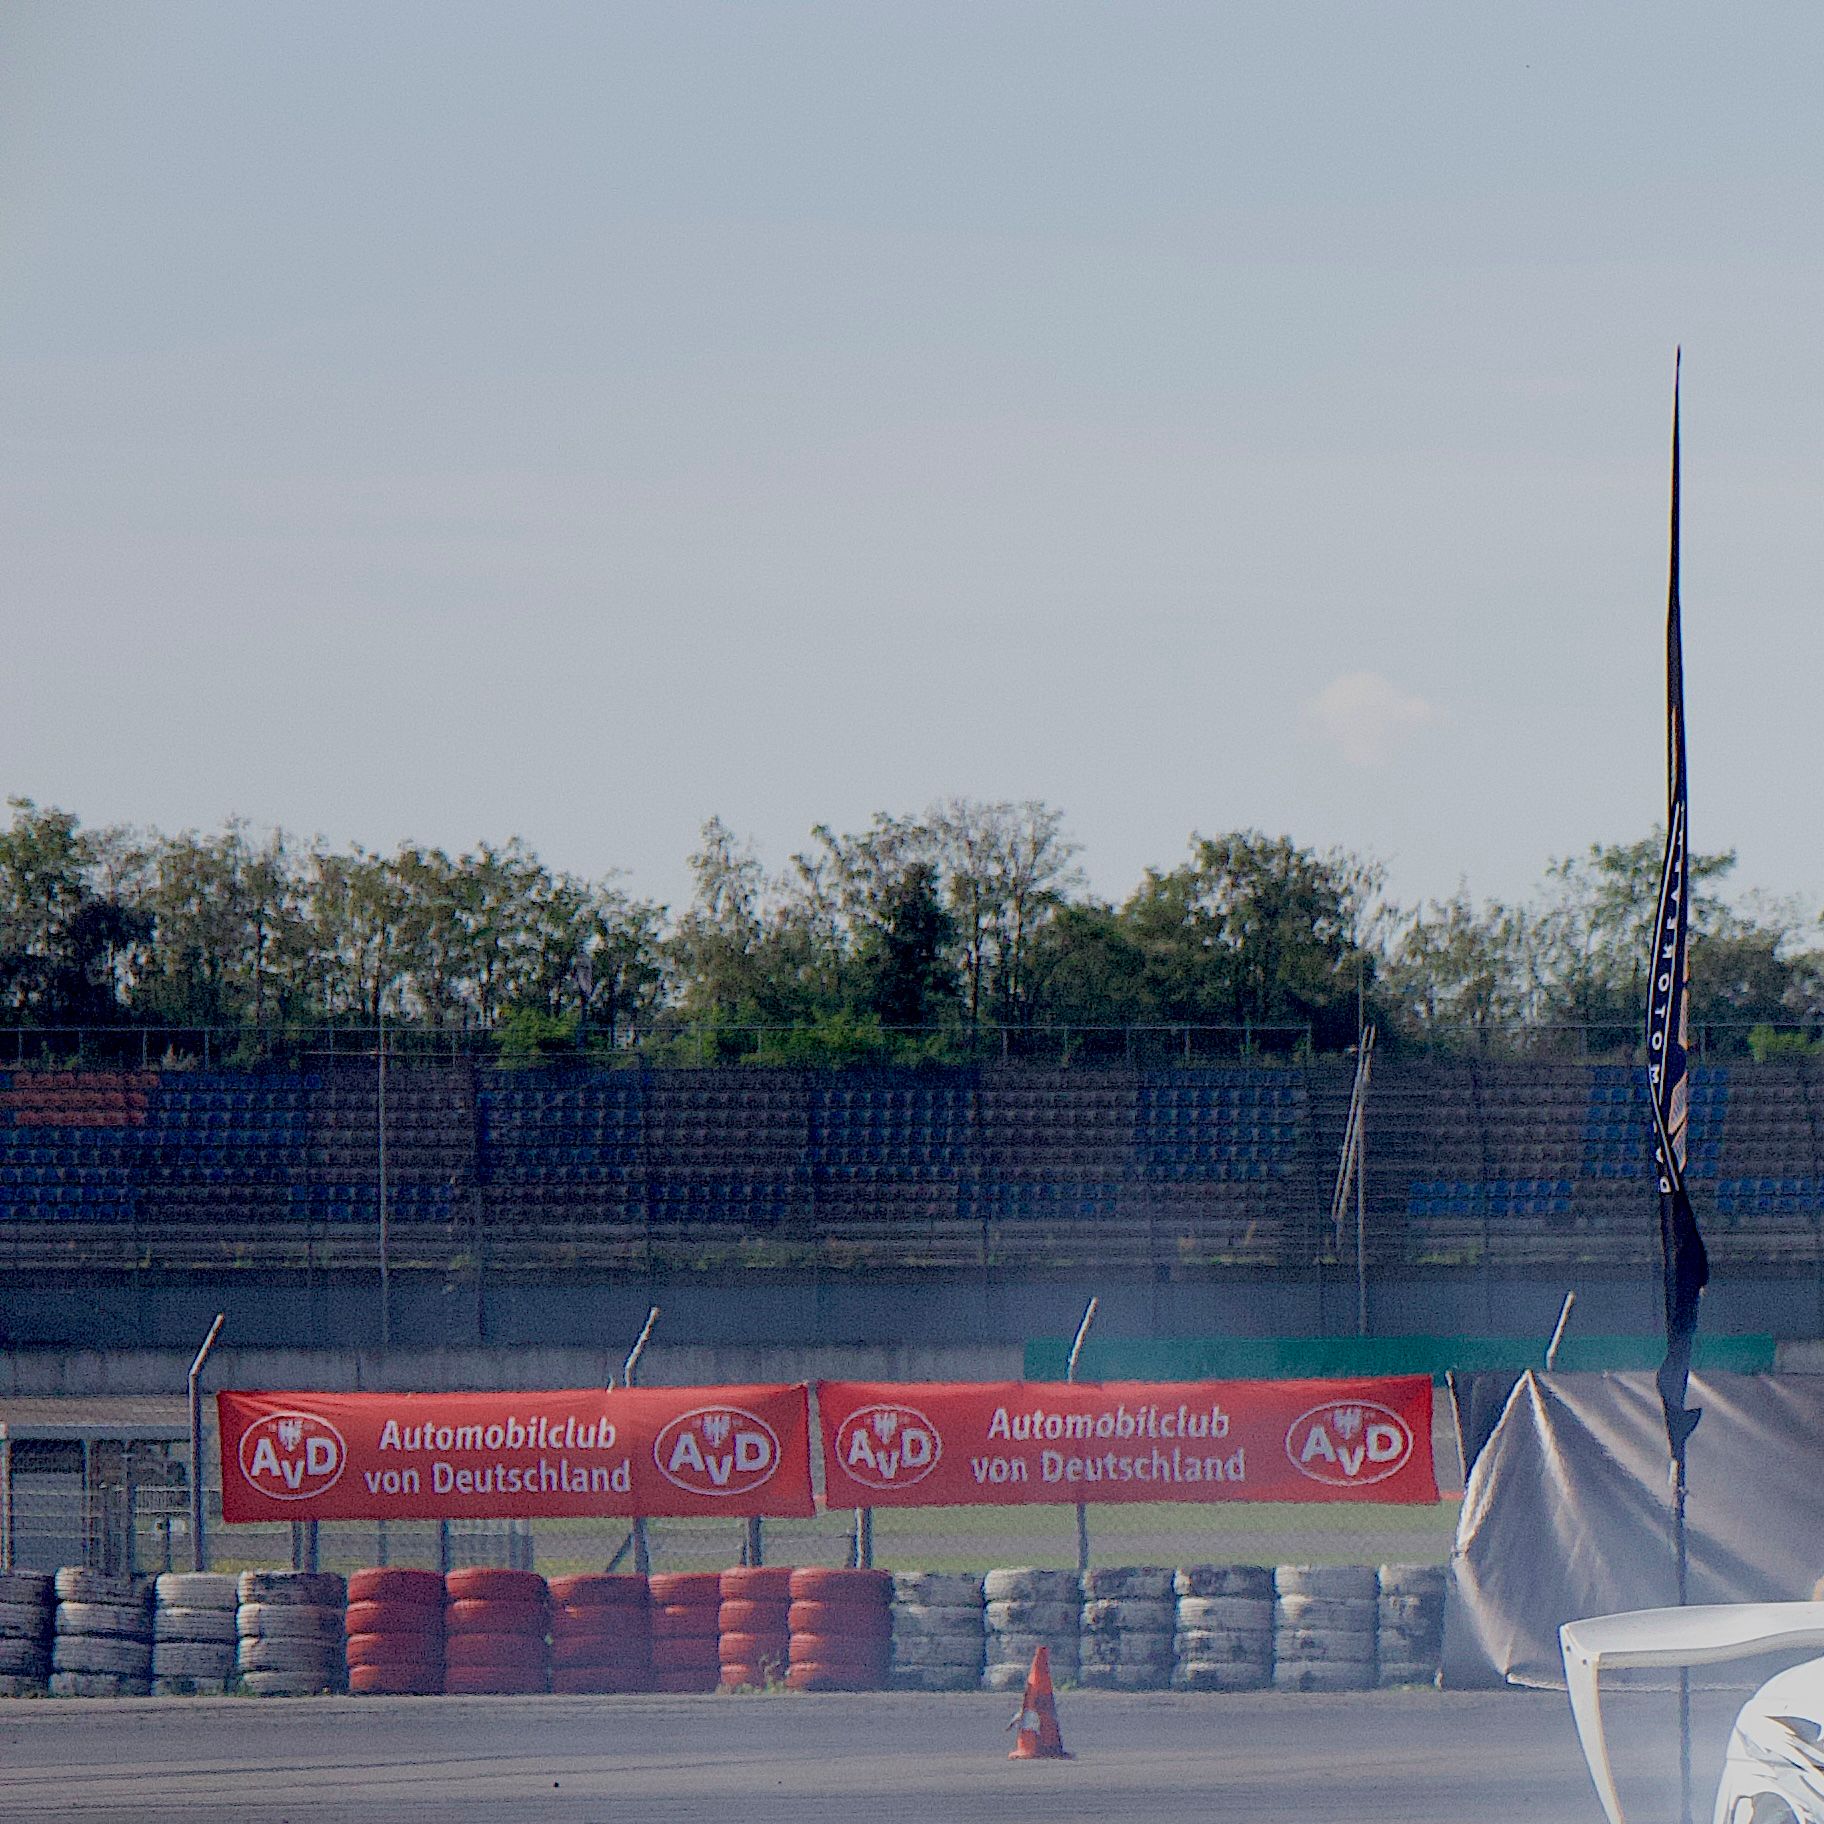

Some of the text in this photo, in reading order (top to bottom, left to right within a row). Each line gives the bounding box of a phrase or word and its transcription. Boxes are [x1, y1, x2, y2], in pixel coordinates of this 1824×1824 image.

[378, 1415, 617, 1451] Automobilclub
[987, 1404, 1230, 1441] Automobilclub
[364, 1458, 631, 1495] von Deutschland
[970, 1446, 1246, 1484] von Deutschland
